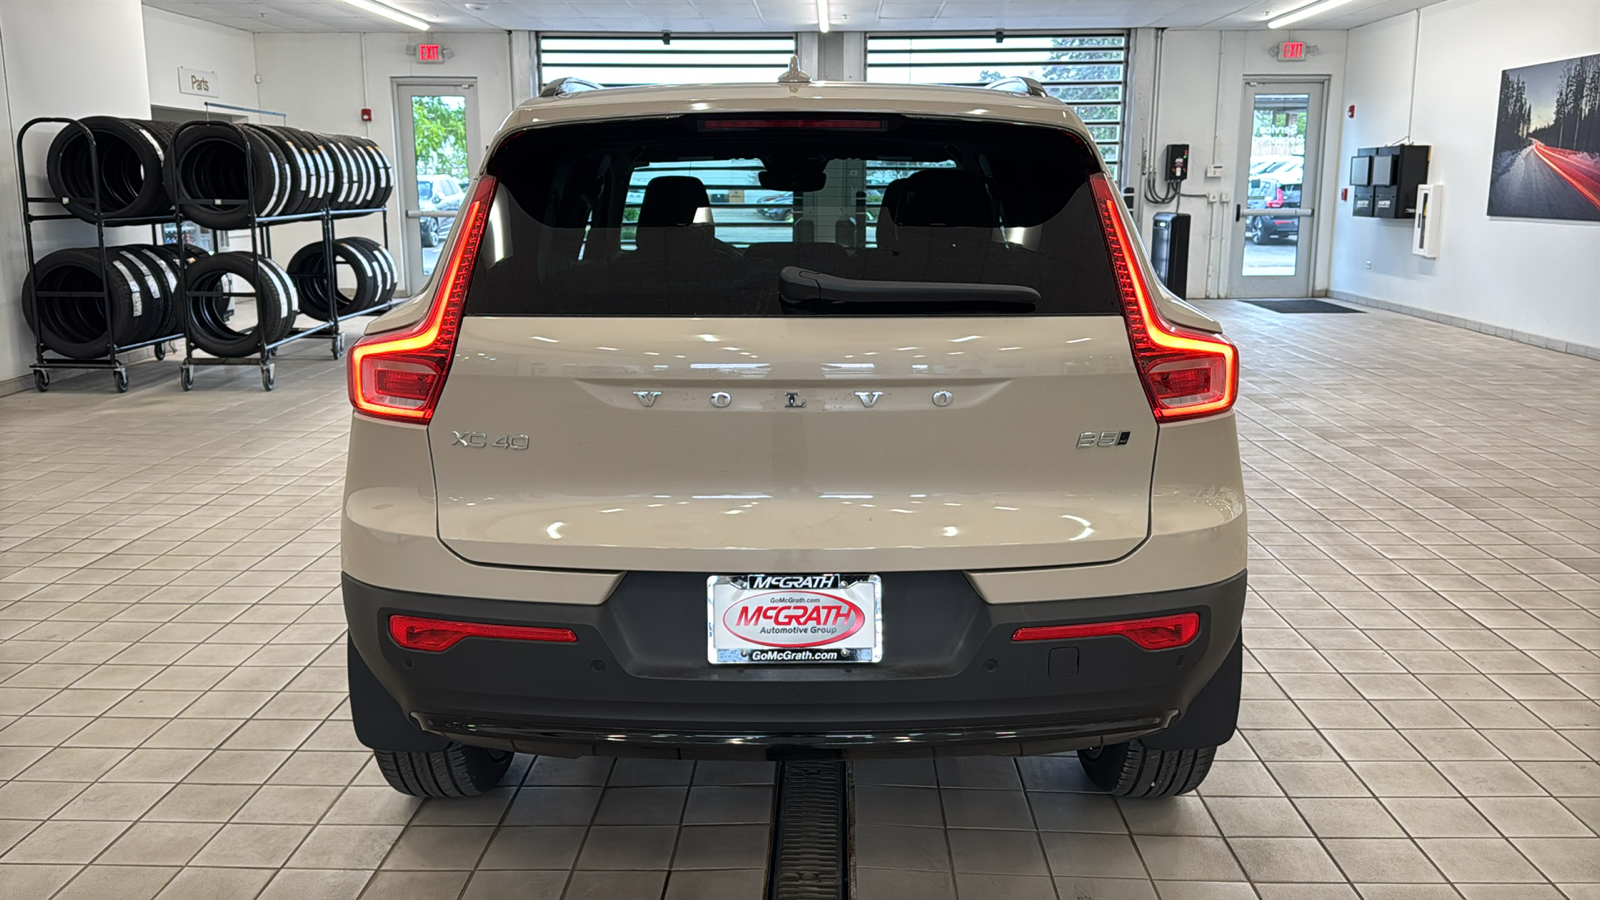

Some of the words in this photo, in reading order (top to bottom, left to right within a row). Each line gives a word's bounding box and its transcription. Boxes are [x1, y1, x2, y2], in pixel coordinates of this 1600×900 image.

[419, 44, 439, 60] EXIT
[1283, 42, 1303, 58] EXIT
[191, 74, 209, 92] Parts
[633, 391, 954, 408] VOLVO
[1076, 431, 1118, 449] B5
[769, 596, 821, 604] GoMcGrath.com
[760, 626, 808, 634] Automotive
[810, 626, 837, 635] Group
[752, 650, 838, 661] GoMcGrath.com
